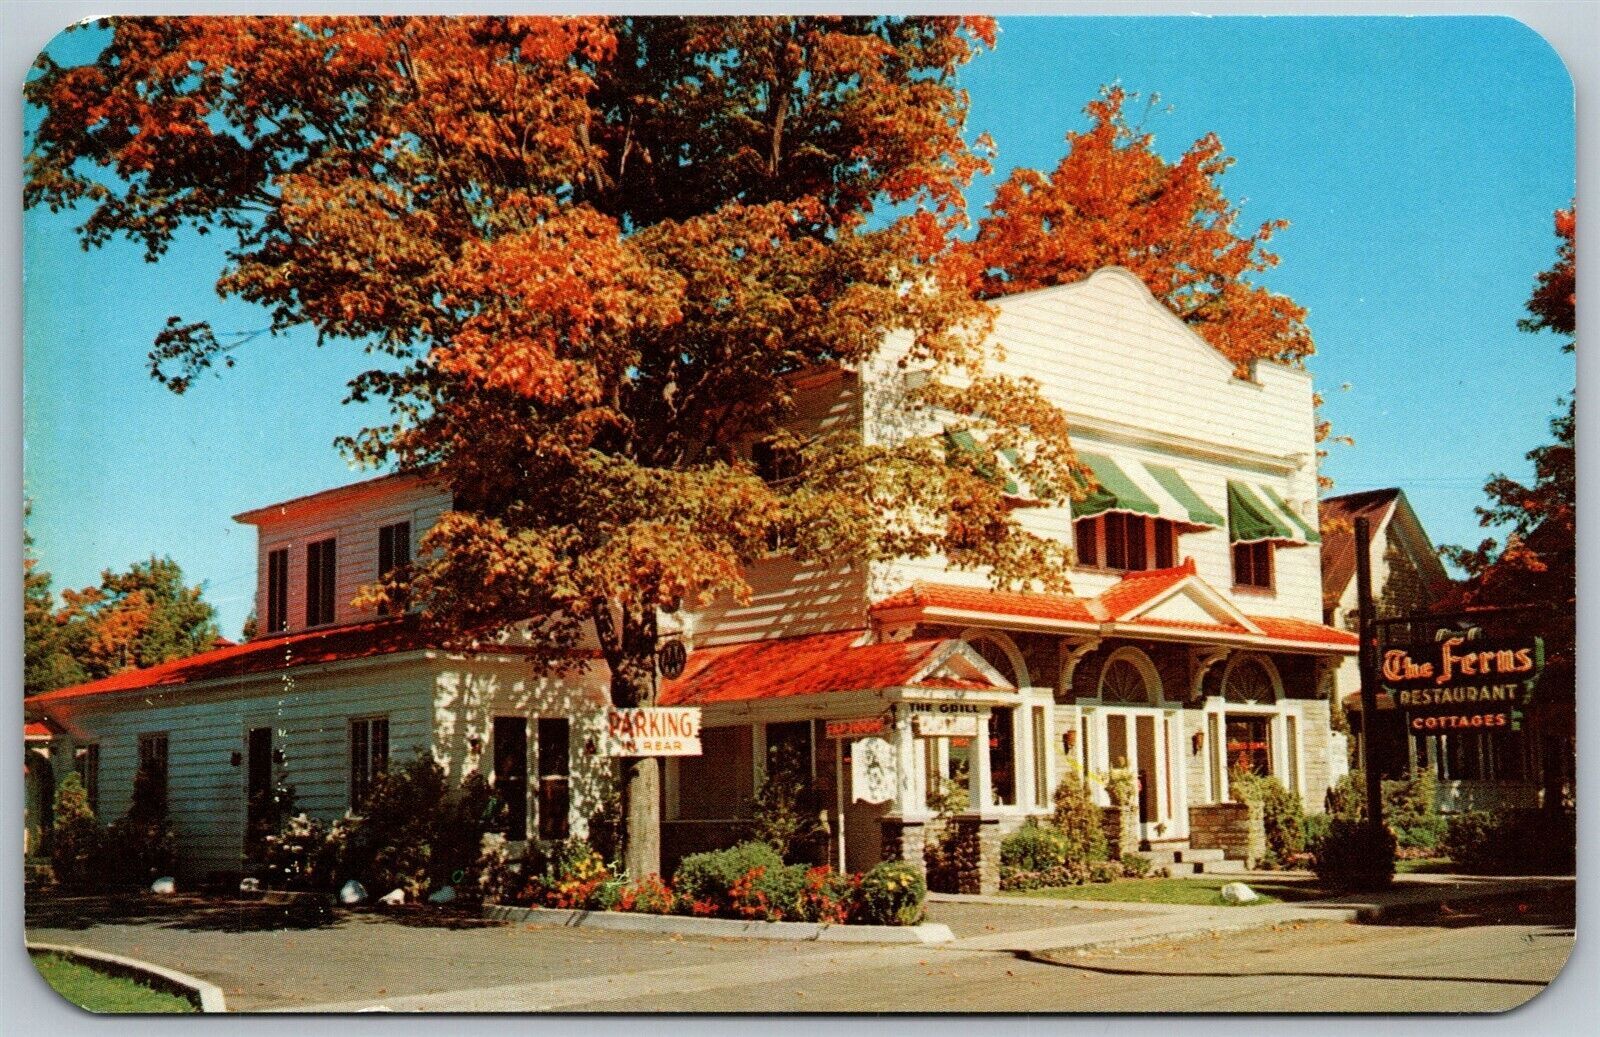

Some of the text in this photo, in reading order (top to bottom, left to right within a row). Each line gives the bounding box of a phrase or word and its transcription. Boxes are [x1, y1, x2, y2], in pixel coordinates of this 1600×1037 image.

[1383, 637, 1533, 684] The Ferns
[1400, 684, 1518, 704] RESTAURANT
[909, 702, 980, 713] THE GRILL
[608, 709, 692, 738] PARKING
[1413, 713, 1506, 729] COTTAGES
[643, 741, 682, 751] REAR
